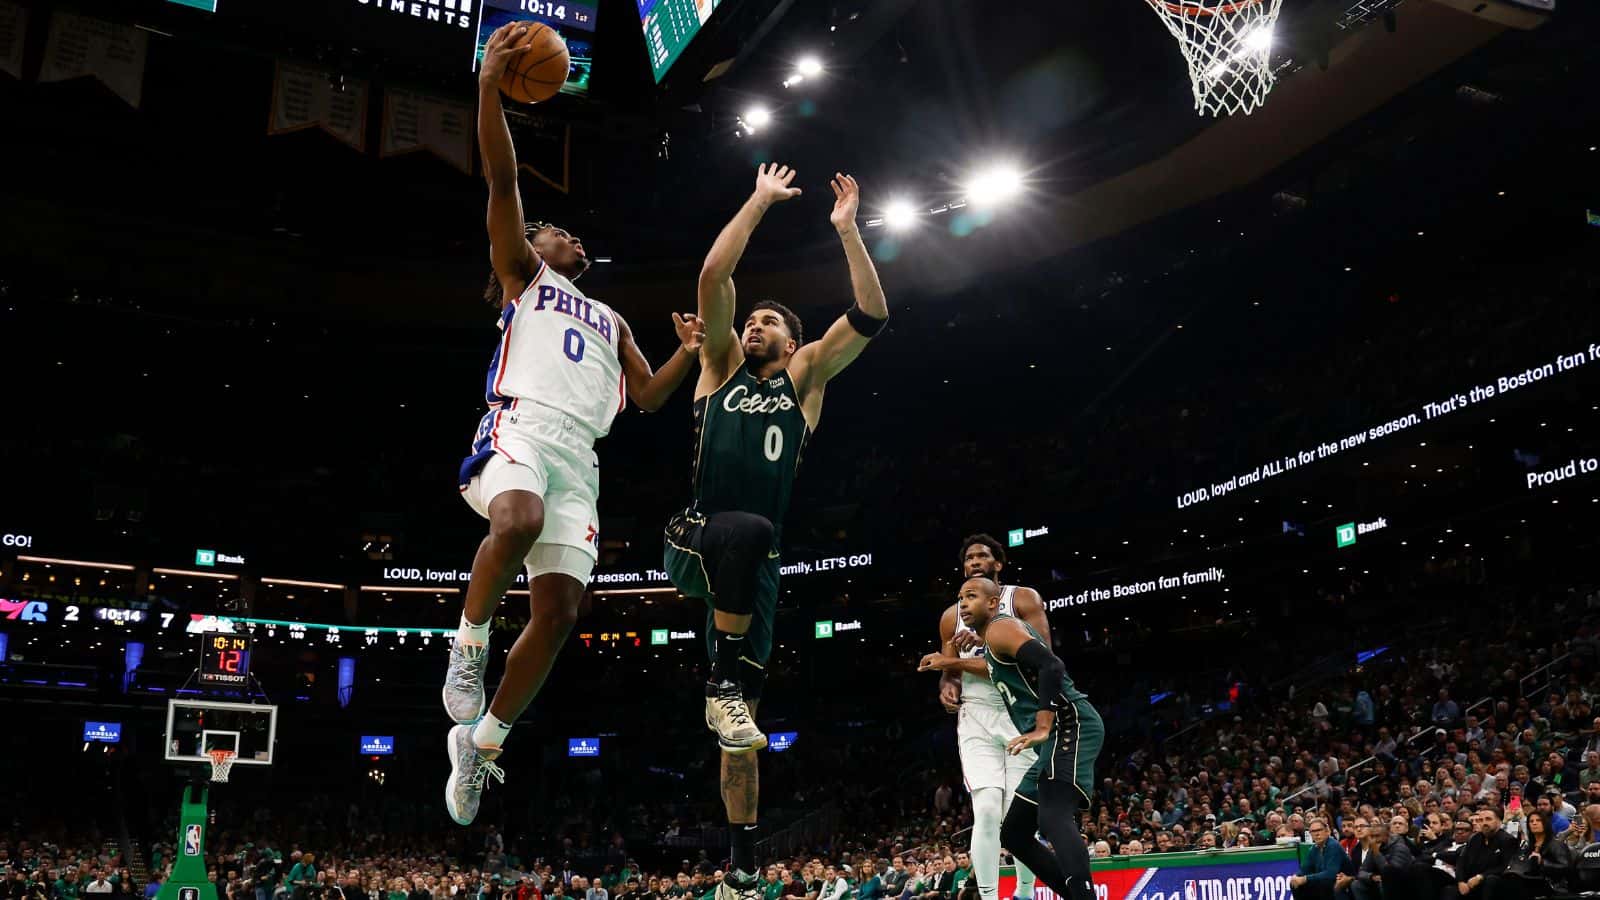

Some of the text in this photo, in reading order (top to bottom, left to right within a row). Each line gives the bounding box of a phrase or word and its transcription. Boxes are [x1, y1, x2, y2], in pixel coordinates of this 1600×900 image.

[520, 0, 566, 20] 10:14
[563, 327, 585, 363] 0
[1177, 488, 1210, 509] LOUD,
[1211, 475, 1237, 497] loyal
[1238, 467, 1260, 487] and
[1262, 460, 1284, 479] ALL
[1285, 456, 1297, 470] in
[1298, 450, 1316, 466] for
[1317, 442, 1338, 458] the
[1340, 431, 1367, 450] new
[1369, 413, 1421, 440] season.
[1422, 394, 1468, 420] That's
[1470, 385, 1495, 403] the
[1498, 363, 1554, 394] Boston
[1556, 351, 1586, 373] fan
[764, 425, 783, 461] 0
[1527, 458, 1598, 489] Proud to
[1357, 516, 1388, 535] Bank
[2, 534, 32, 548] GO!
[383, 567, 424, 581] LOUD,
[426, 568, 457, 582] loyal
[597, 572, 643, 583] season.
[645, 569, 669, 581] Tha
[779, 560, 813, 575] amily.
[815, 556, 847, 571] LET'S
[849, 553, 872, 567] GO!
[1049, 594, 1074, 612] part
[1075, 590, 1089, 605] of
[1090, 587, 1111, 602] the
[1113, 581, 1156, 598] Boston
[1158, 576, 1180, 590] fan
[1182, 566, 1225, 586] family.
[64, 605, 80, 621] 2
[98, 608, 141, 622] 10:14
[160, 613, 175, 628] 7
[834, 619, 861, 632] Bank
[213, 637, 246, 650] 10:14
[670, 630, 696, 640] Bank
[217, 650, 241, 672] 12
[215, 674, 246, 682] TISSOT
